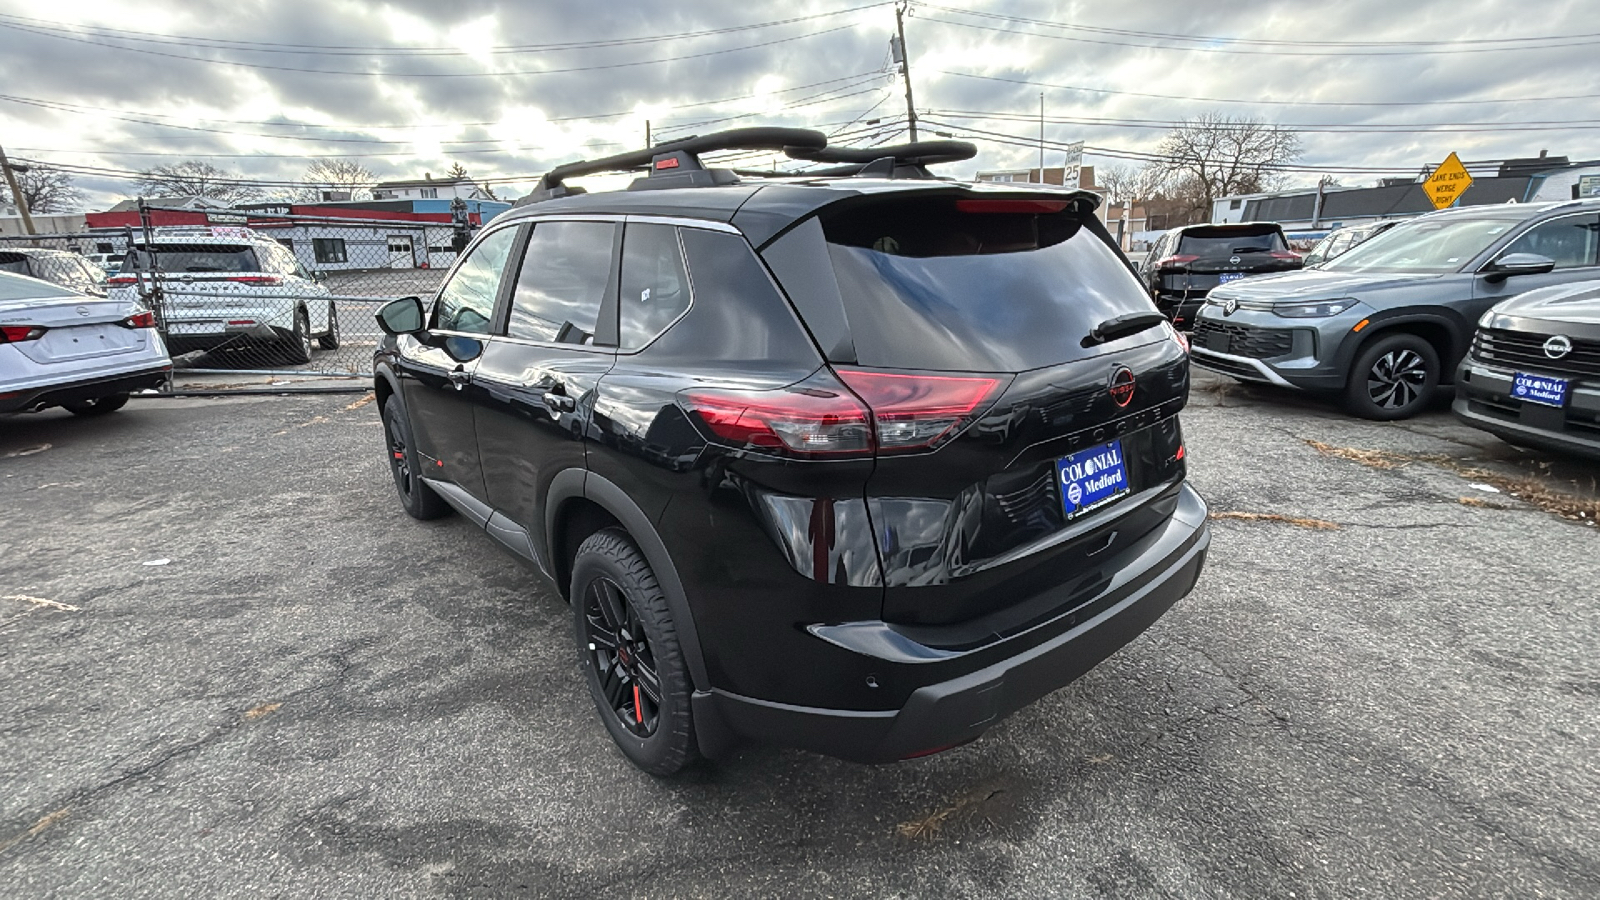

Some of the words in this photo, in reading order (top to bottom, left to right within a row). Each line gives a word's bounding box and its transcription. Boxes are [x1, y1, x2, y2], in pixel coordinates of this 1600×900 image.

[1065, 165, 1079, 181] 25
[1432, 173, 1447, 182] LANE
[1449, 172, 1465, 180] ENDS
[1436, 184, 1456, 193] MERGE
[1435, 195, 1453, 204] RIGHT
[1516, 378, 1565, 394] COLONIAL
[1529, 389, 1561, 401] Medford
[1061, 449, 1121, 485] COLONIAL
[1084, 469, 1122, 495] Medford
